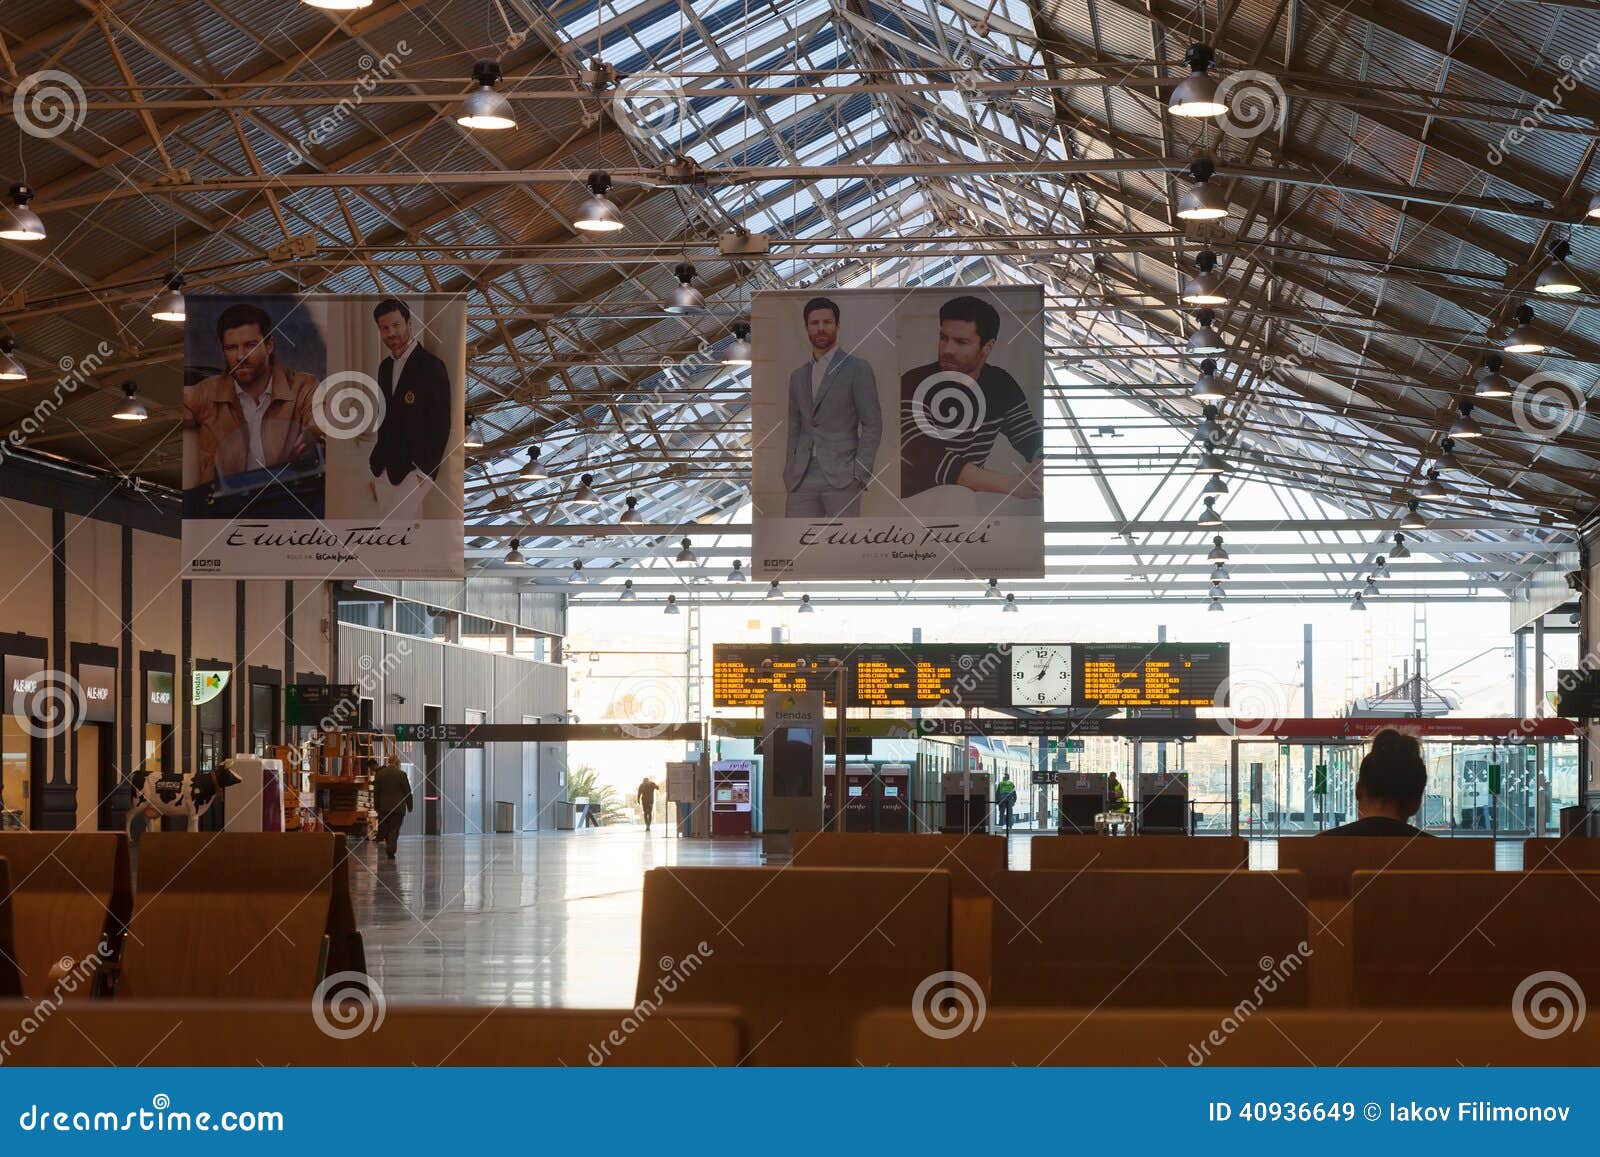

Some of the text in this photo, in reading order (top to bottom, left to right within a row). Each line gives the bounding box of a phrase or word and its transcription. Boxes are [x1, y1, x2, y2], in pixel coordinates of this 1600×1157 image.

[226, 524, 410, 548] Emidio Tucci
[800, 523, 992, 546] Emidio Tucci
[775, 710, 813, 720] tiendas
[416, 725, 446, 740] 8:13
